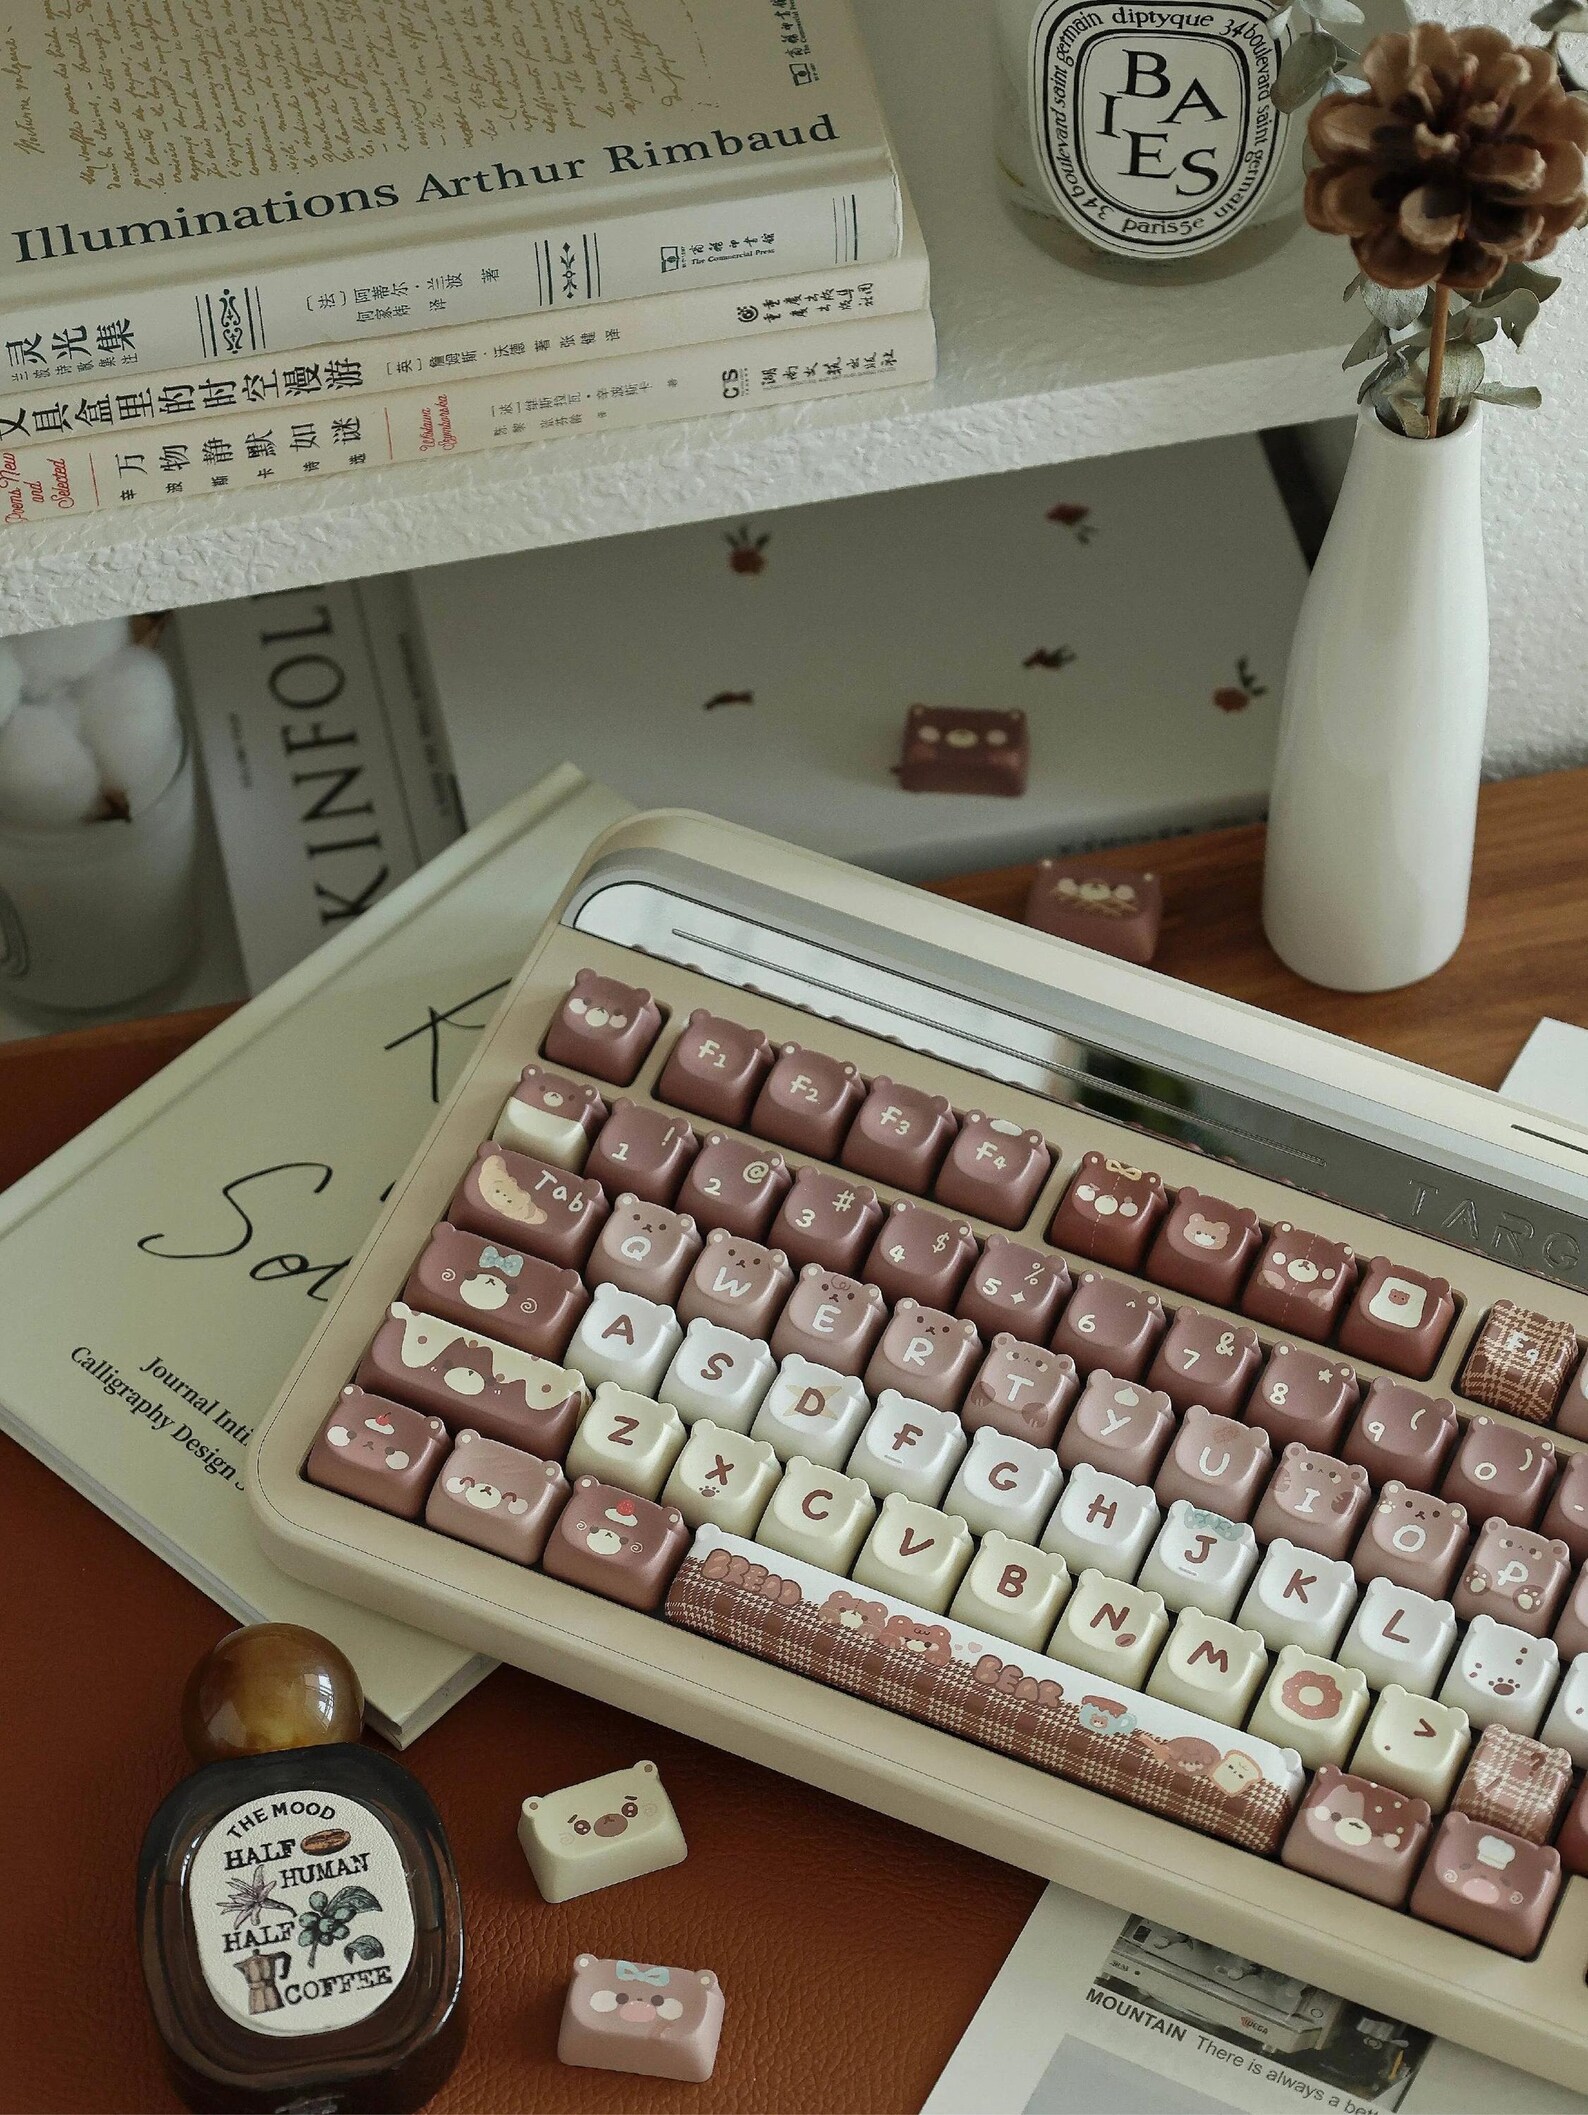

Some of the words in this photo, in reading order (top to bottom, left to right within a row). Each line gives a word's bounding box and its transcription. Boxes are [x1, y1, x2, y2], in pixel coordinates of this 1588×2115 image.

[1111, 6, 1214, 29] diptyque
[1056, 11, 1104, 68] germain
[1050, 65, 1069, 108] saint
[1254, 104, 1273, 146] saint
[1050, 106, 1086, 198] boulevard
[11, 189, 400, 264] Illuminations
[415, 157, 587, 204] Arthur
[603, 113, 841, 175] Rimbaud
[1082, 197, 1115, 221] 34
[708, 251, 753, 263] Commercial
[481, 267, 500, 284] 著
[429, 297, 448, 313] 译
[5, 318, 136, 368] 灵光集
[534, 338, 551, 353] 著
[605, 327, 621, 342] 译
[12, 352, 139, 383] 兰波诗歌集注
[0, 357, 364, 441] 文具盒里的时空漫游
[115, 415, 362, 479] 万物静默如谜
[0, 452, 21, 488] New
[46, 458, 75, 509] Selected
[119, 452, 367, 501] 辛波斯卡诗选
[5, 487, 28, 524] Poems
[23, 480, 45, 503] and
[698, 1040, 726, 1068] F1
[789, 1075, 820, 1105] F2
[880, 1106, 912, 1136] F3
[611, 1142, 631, 1162] 1
[974, 1142, 1009, 1172] F4
[534, 1170, 584, 1214] Tab
[703, 1178, 723, 1197] 2
[795, 1208, 817, 1229] 3
[620, 1236, 654, 1261] Q
[888, 1244, 906, 1263] 4
[712, 1267, 753, 1298] W
[981, 1277, 1004, 1297] 5
[601, 1314, 635, 1346] A
[812, 1305, 841, 1333] E
[1077, 1313, 1096, 1333] 6
[700, 1352, 735, 1381] S
[902, 1337, 935, 1368] R
[1182, 1348, 1201, 1371] 7
[139, 1356, 221, 1417] Journal
[793, 1387, 827, 1417] D
[1005, 1373, 1039, 1403] T
[1269, 1382, 1290, 1405] 8
[70, 1346, 176, 1431] Calligraphy
[170, 1423, 237, 1482] Design
[607, 1415, 641, 1446] Z
[892, 1421, 925, 1452] F
[1367, 1422, 1385, 1443] 9
[704, 1454, 736, 1486] X
[987, 1460, 1019, 1492] G
[1199, 1446, 1231, 1477] U
[801, 1488, 835, 1522] C
[1086, 1493, 1119, 1529] H
[1293, 1487, 1322, 1514] I
[897, 1526, 936, 1557] V
[1184, 1533, 1218, 1565] J
[1392, 1523, 1427, 1553] O
[996, 1563, 1030, 1599] B
[1282, 1567, 1318, 1604] K
[1497, 1560, 1529, 1586] P
[1089, 1602, 1131, 1632] N
[1382, 1608, 1411, 1644] L
[1186, 1640, 1229, 1674] M
[227, 1807, 269, 1842] THE
[270, 1800, 337, 1821] MOOD
[224, 1838, 297, 1871] HALF
[279, 1852, 371, 1889] HUMAN
[223, 1920, 296, 1954] HALF
[284, 1965, 393, 2006] COFFEE
[1085, 1987, 1188, 2043] MOUNTAIN
[1195, 2034, 1245, 2068] There
[1246, 2057, 1264, 2076] is
[1265, 2068, 1325, 2101] always
[1328, 2096, 1341, 2108] a
